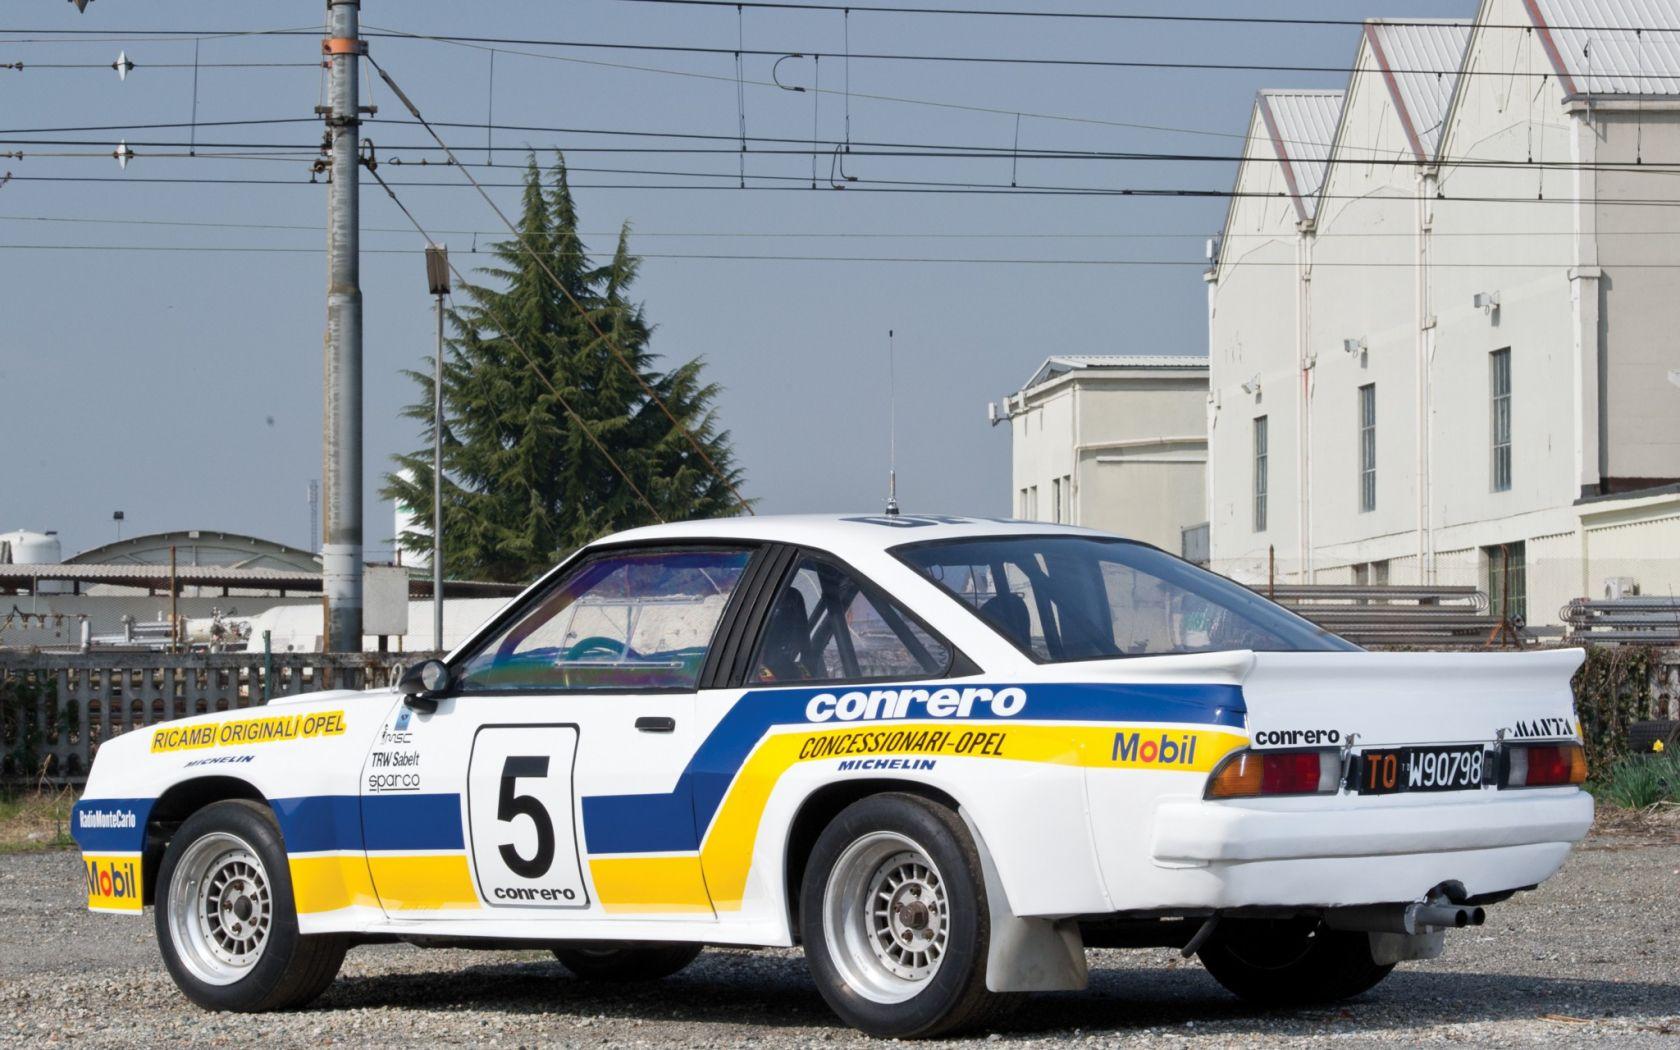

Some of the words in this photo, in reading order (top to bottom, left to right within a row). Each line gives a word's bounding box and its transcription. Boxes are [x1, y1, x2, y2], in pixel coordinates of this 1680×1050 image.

[805, 687, 1017, 722] conrero
[153, 727, 216, 750] RICAMBI
[220, 718, 299, 743] ORIGINALI
[303, 714, 344, 735] OPEL
[1256, 729, 1340, 745] conrero
[1514, 718, 1574, 737] MANTA
[1112, 732, 1197, 765] Mobil
[184, 755, 255, 768] MICHELIN
[372, 752, 393, 767] TRW
[393, 750, 420, 767] Sabelt
[838, 759, 936, 771] MICHELIN
[1367, 754, 1396, 789] TO
[1409, 751, 1481, 787] W90798
[369, 774, 420, 792] sparco
[79, 809, 136, 828] RadioMonteCarlo
[497, 756, 555, 879] 5
[83, 860, 136, 898] Mobil
[494, 886, 576, 901] conrero
